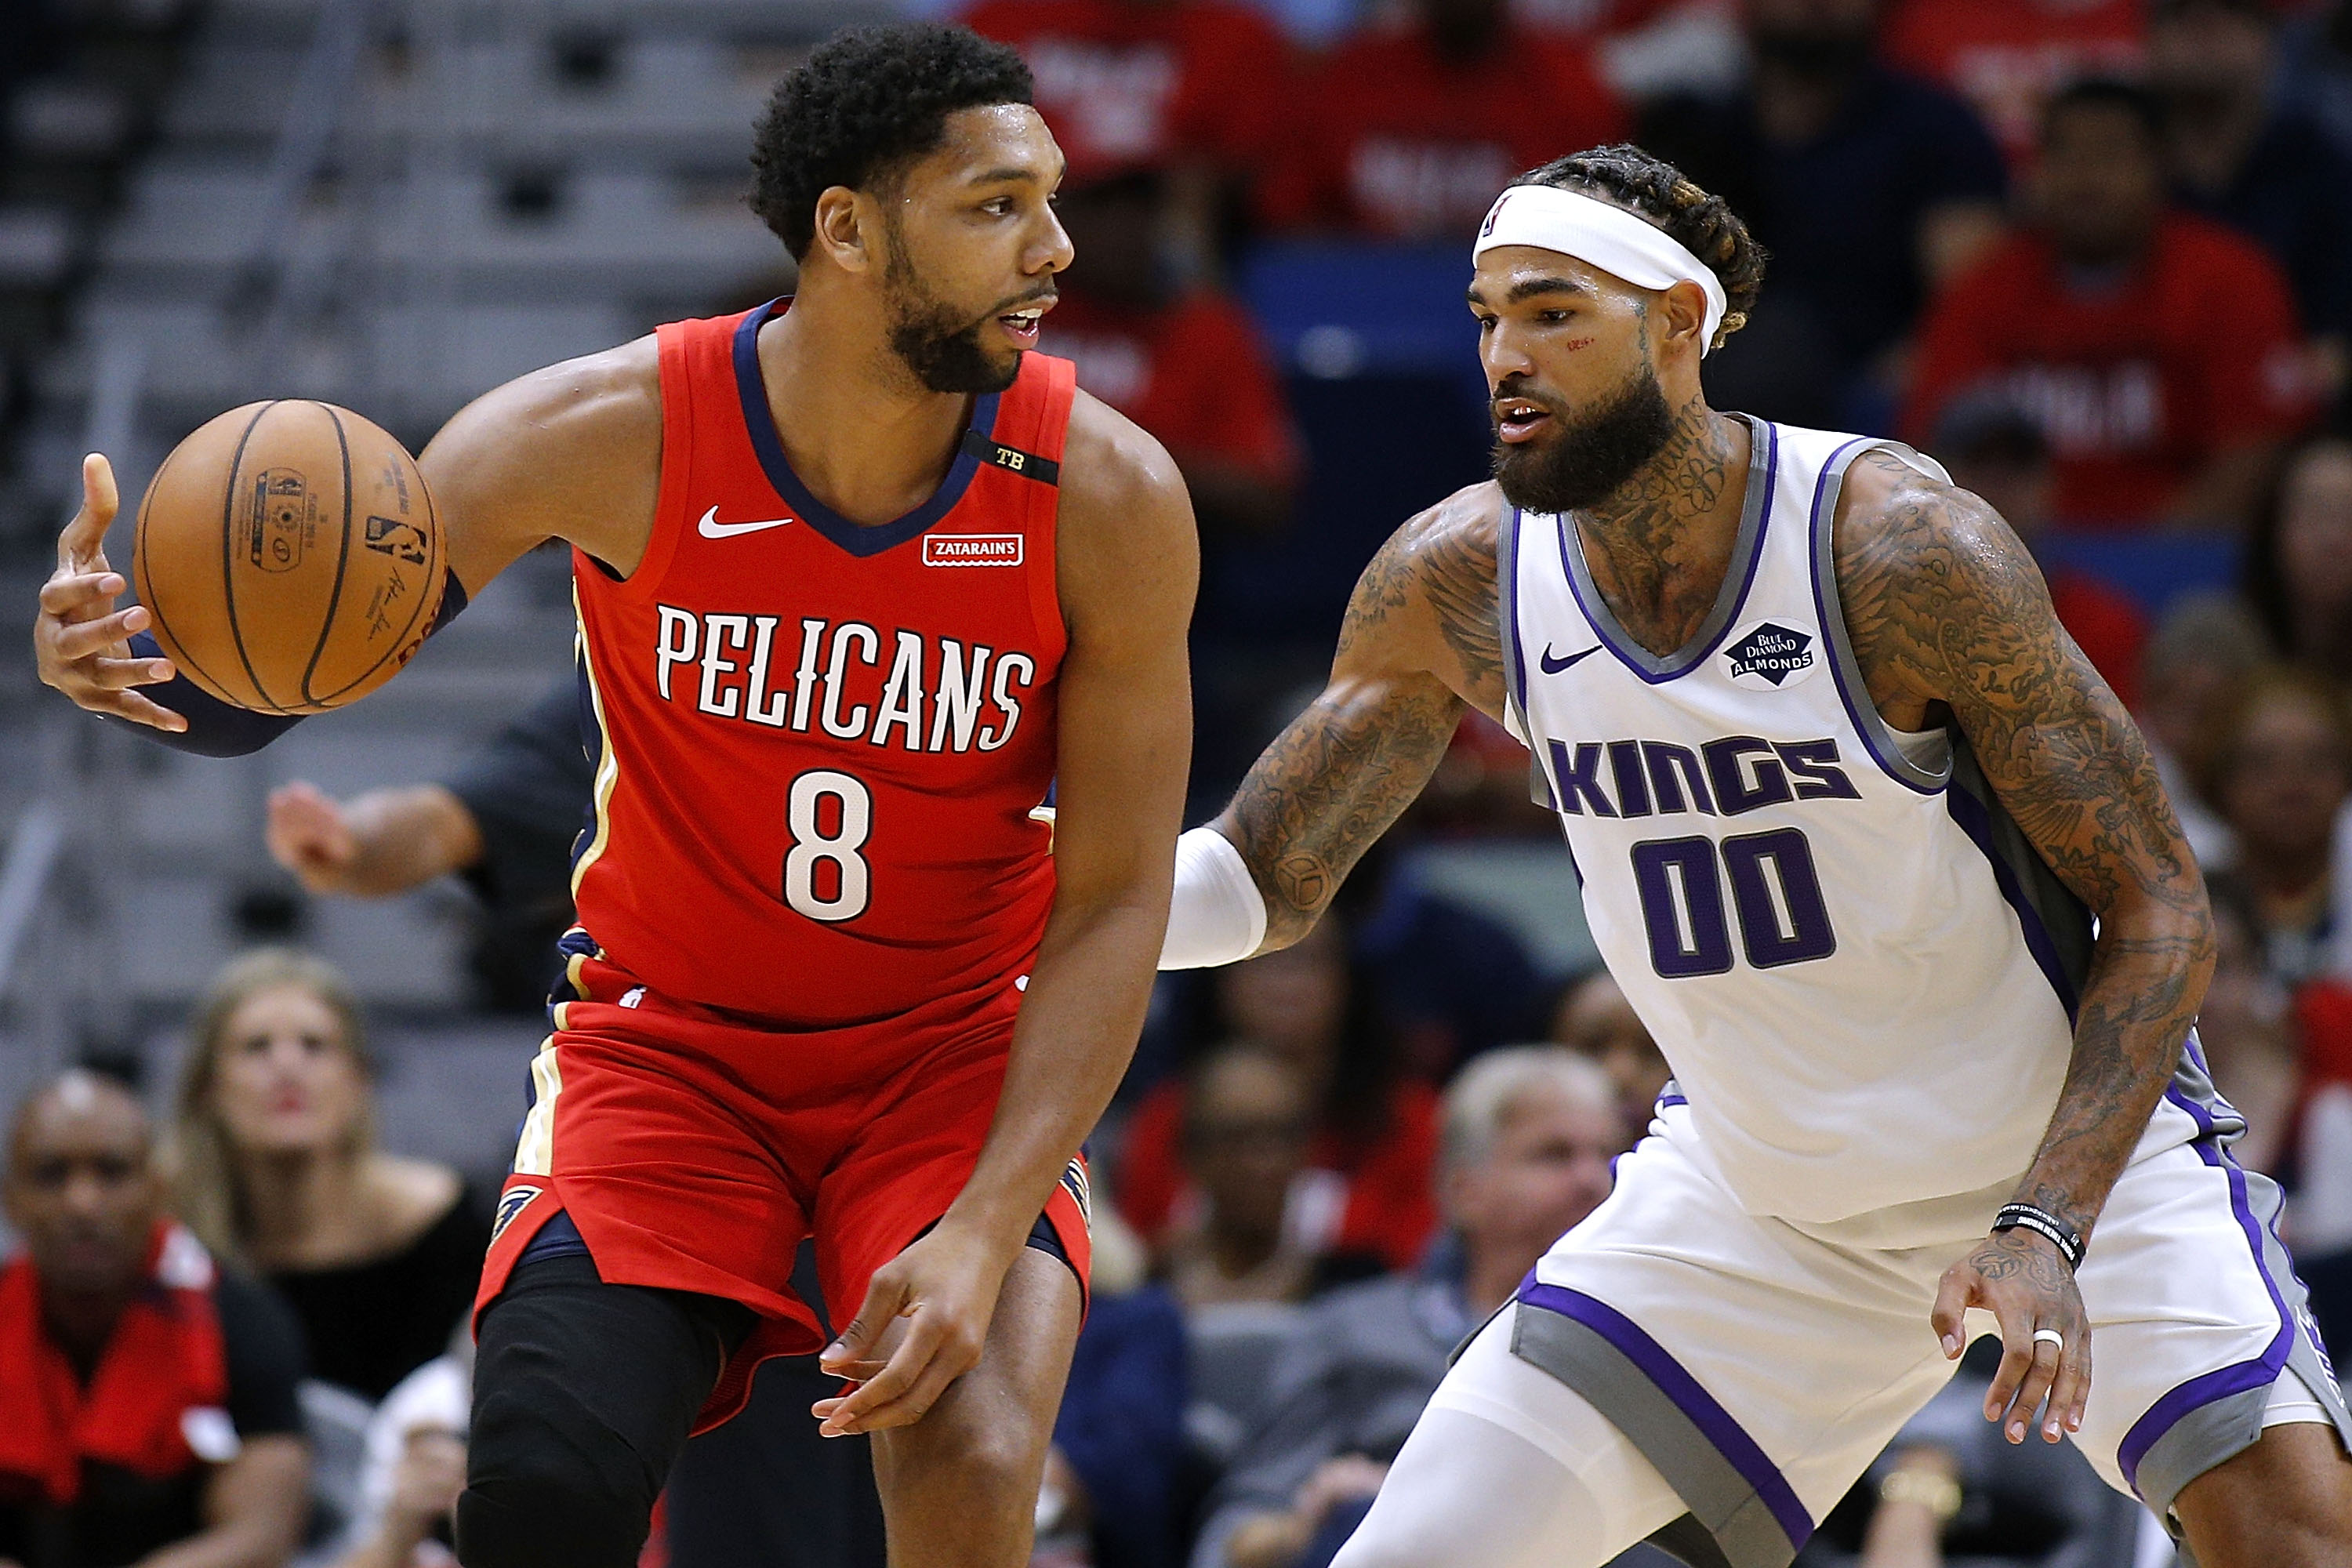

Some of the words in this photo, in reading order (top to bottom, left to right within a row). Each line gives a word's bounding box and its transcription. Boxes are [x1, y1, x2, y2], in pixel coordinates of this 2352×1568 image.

[996, 448, 1025, 470] TB
[935, 541, 1016, 556] ZATARAIN'S
[1745, 639, 1796, 659] DIAMOND
[1734, 654, 1811, 675] ALMONDS
[655, 603, 1035, 754] PELICANS
[1547, 735, 1863, 819] KINGS
[783, 768, 873, 924] 8
[1630, 826, 1837, 980] 00
[2017, 1216, 2045, 1232] WRONG
[2042, 1225, 2061, 1244] THEM
